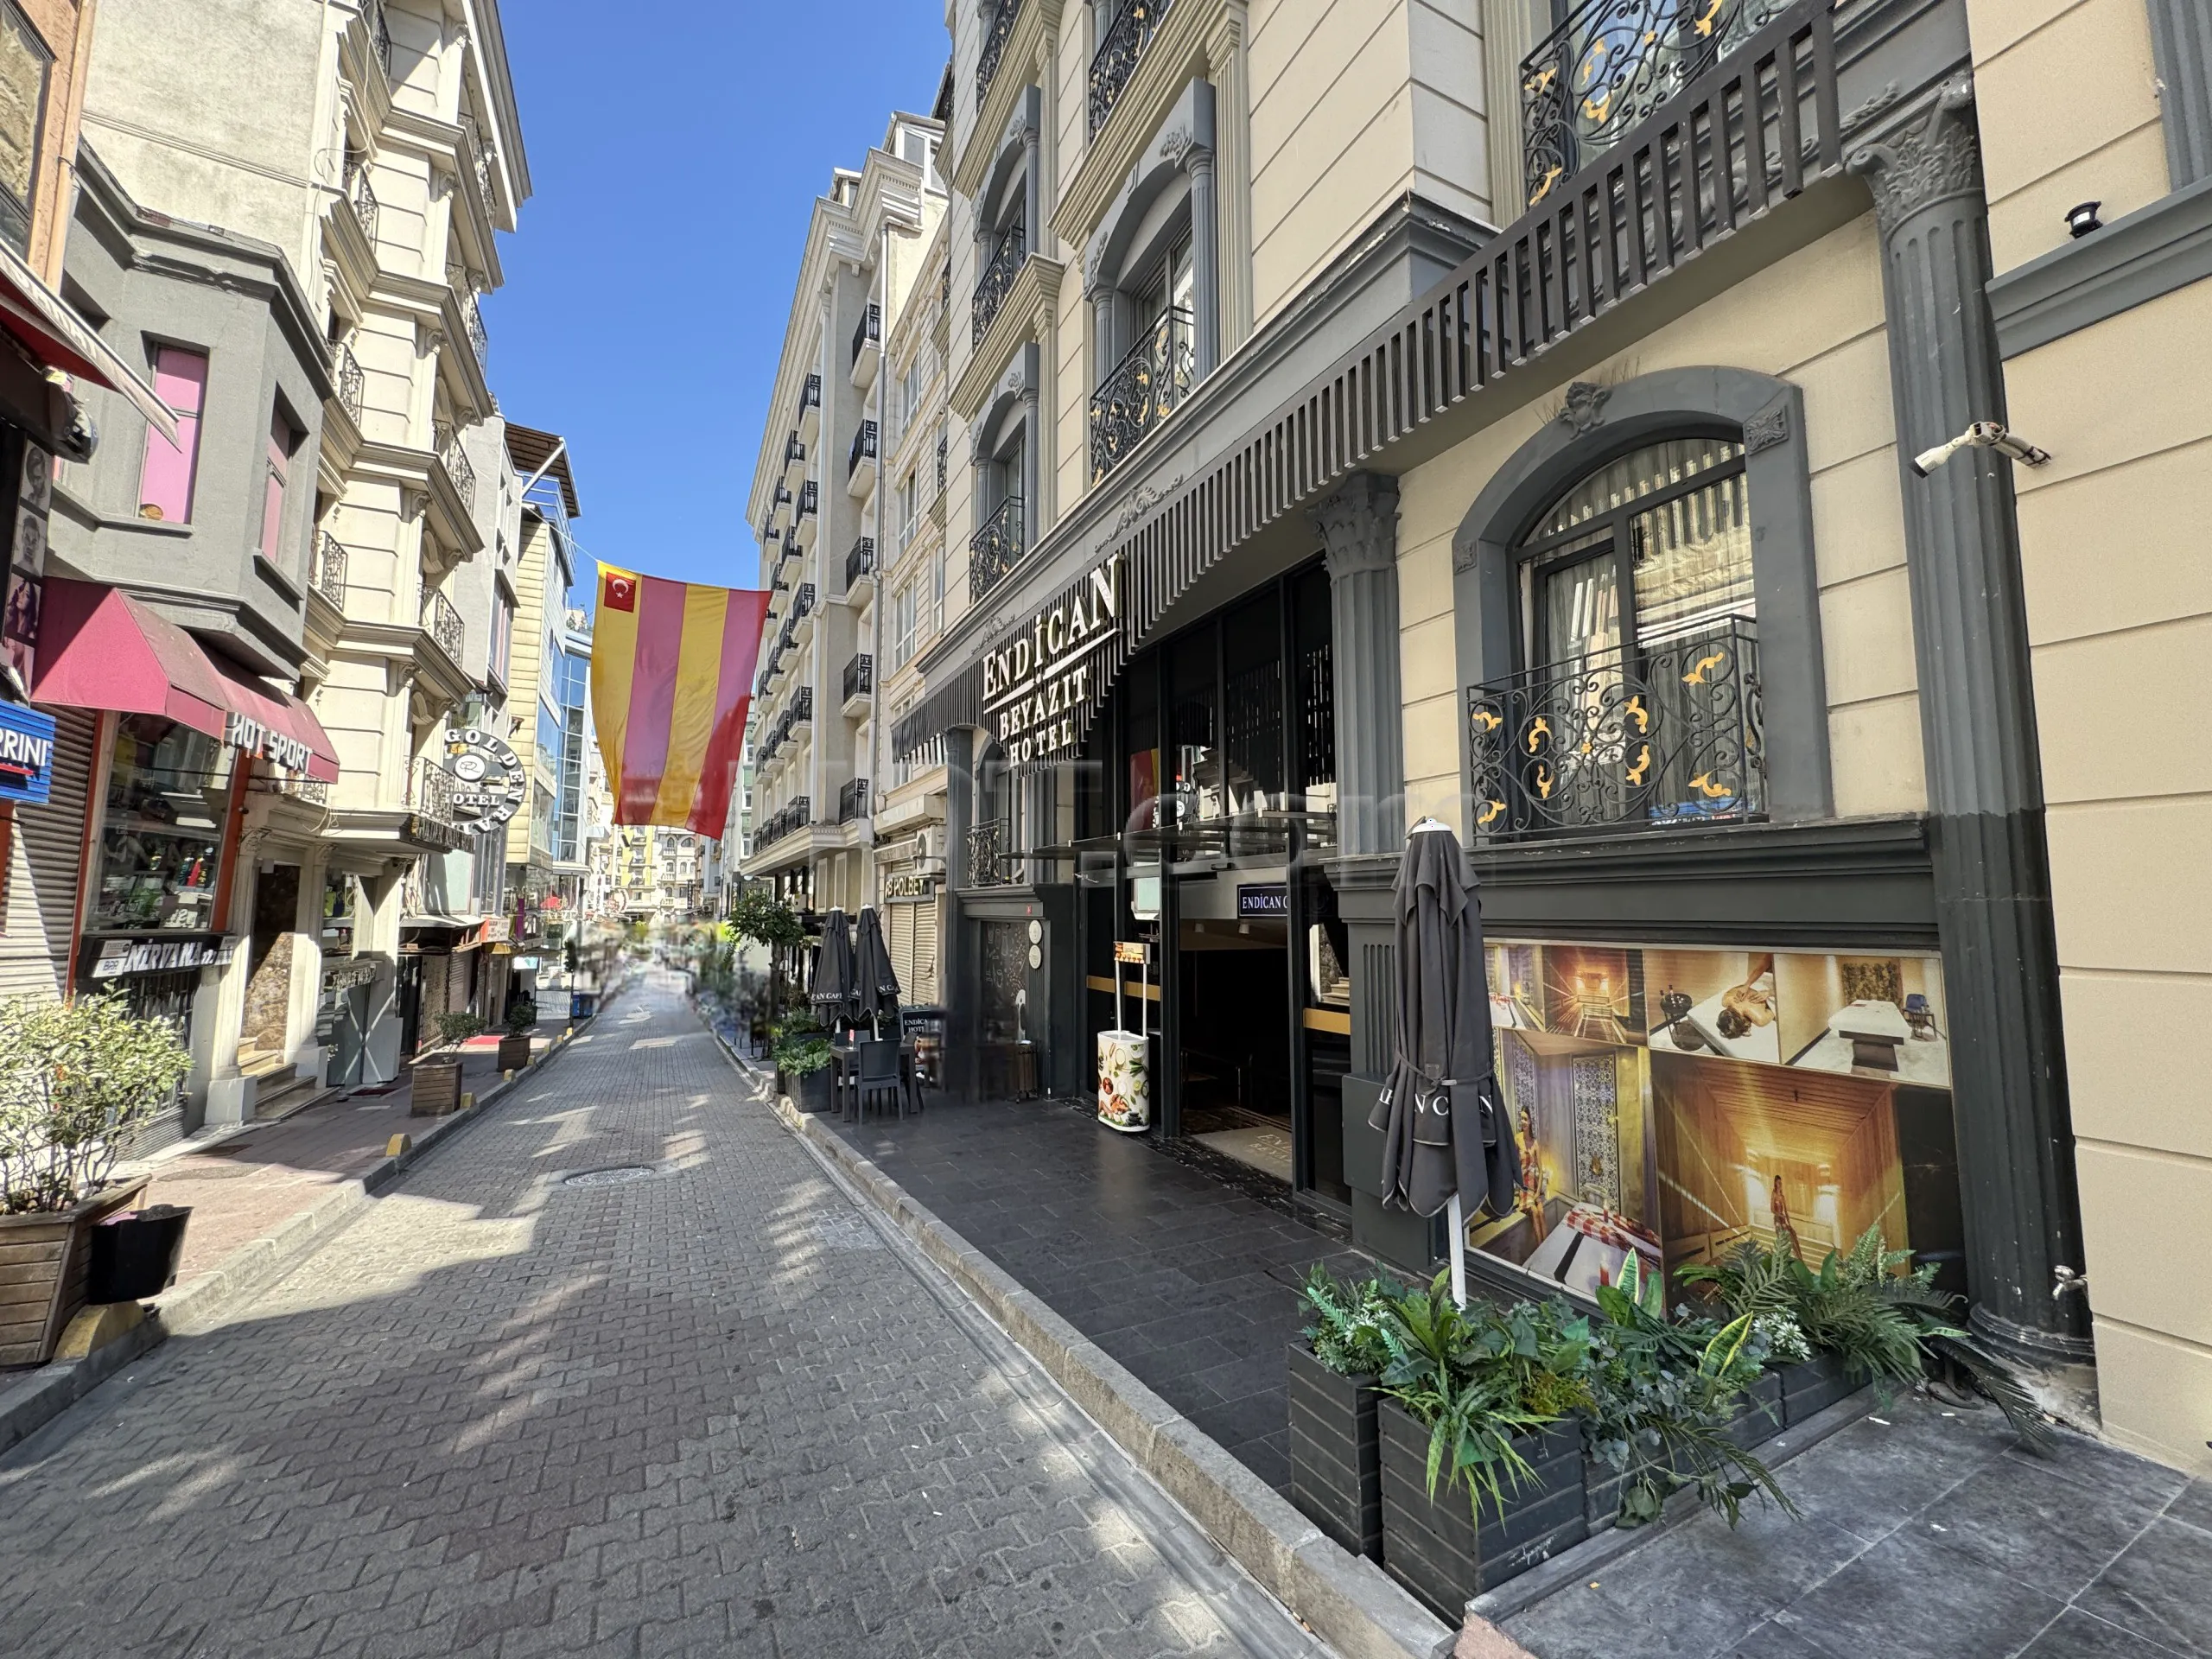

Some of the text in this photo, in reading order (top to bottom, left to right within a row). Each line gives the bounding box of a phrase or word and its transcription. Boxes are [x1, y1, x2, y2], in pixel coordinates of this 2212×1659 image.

[999, 664, 1089, 742] BEYAZIT
[229, 712, 313, 774] HOT SPORT
[444, 729, 525, 803] GOLDEN
[1009, 719, 1073, 768] HOTEL
[893, 875, 924, 897] POLBEY
[1242, 893, 1281, 909] ENDİCAN
[124, 938, 203, 973] NİRVANA
